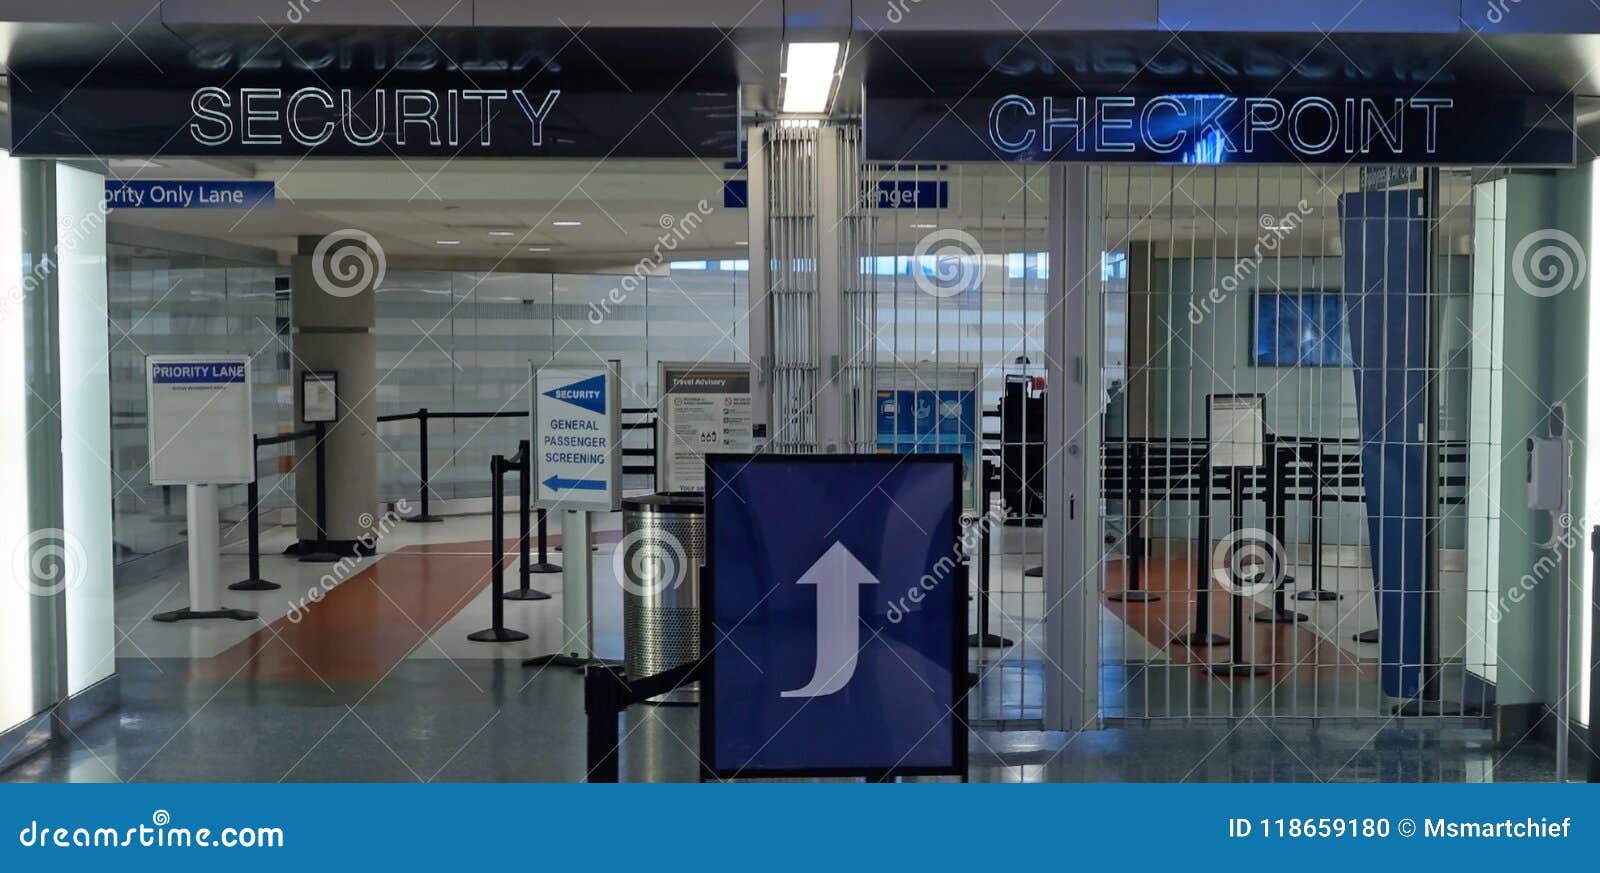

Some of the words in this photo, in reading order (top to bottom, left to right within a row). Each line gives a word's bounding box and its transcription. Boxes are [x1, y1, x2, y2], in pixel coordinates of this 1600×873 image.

[190, 86, 561, 146] SECURITY
[988, 94, 1454, 154] CHECKPOINT
[150, 185, 194, 207] Only
[199, 186, 244, 203] Lane
[153, 366, 209, 378] PRIORITY
[212, 366, 246, 378] LANE
[555, 390, 601, 400] SECURITY
[550, 419, 600, 431] GENERAL
[544, 436, 607, 448] PASSENGER
[545, 452, 605, 464] SCREENING
